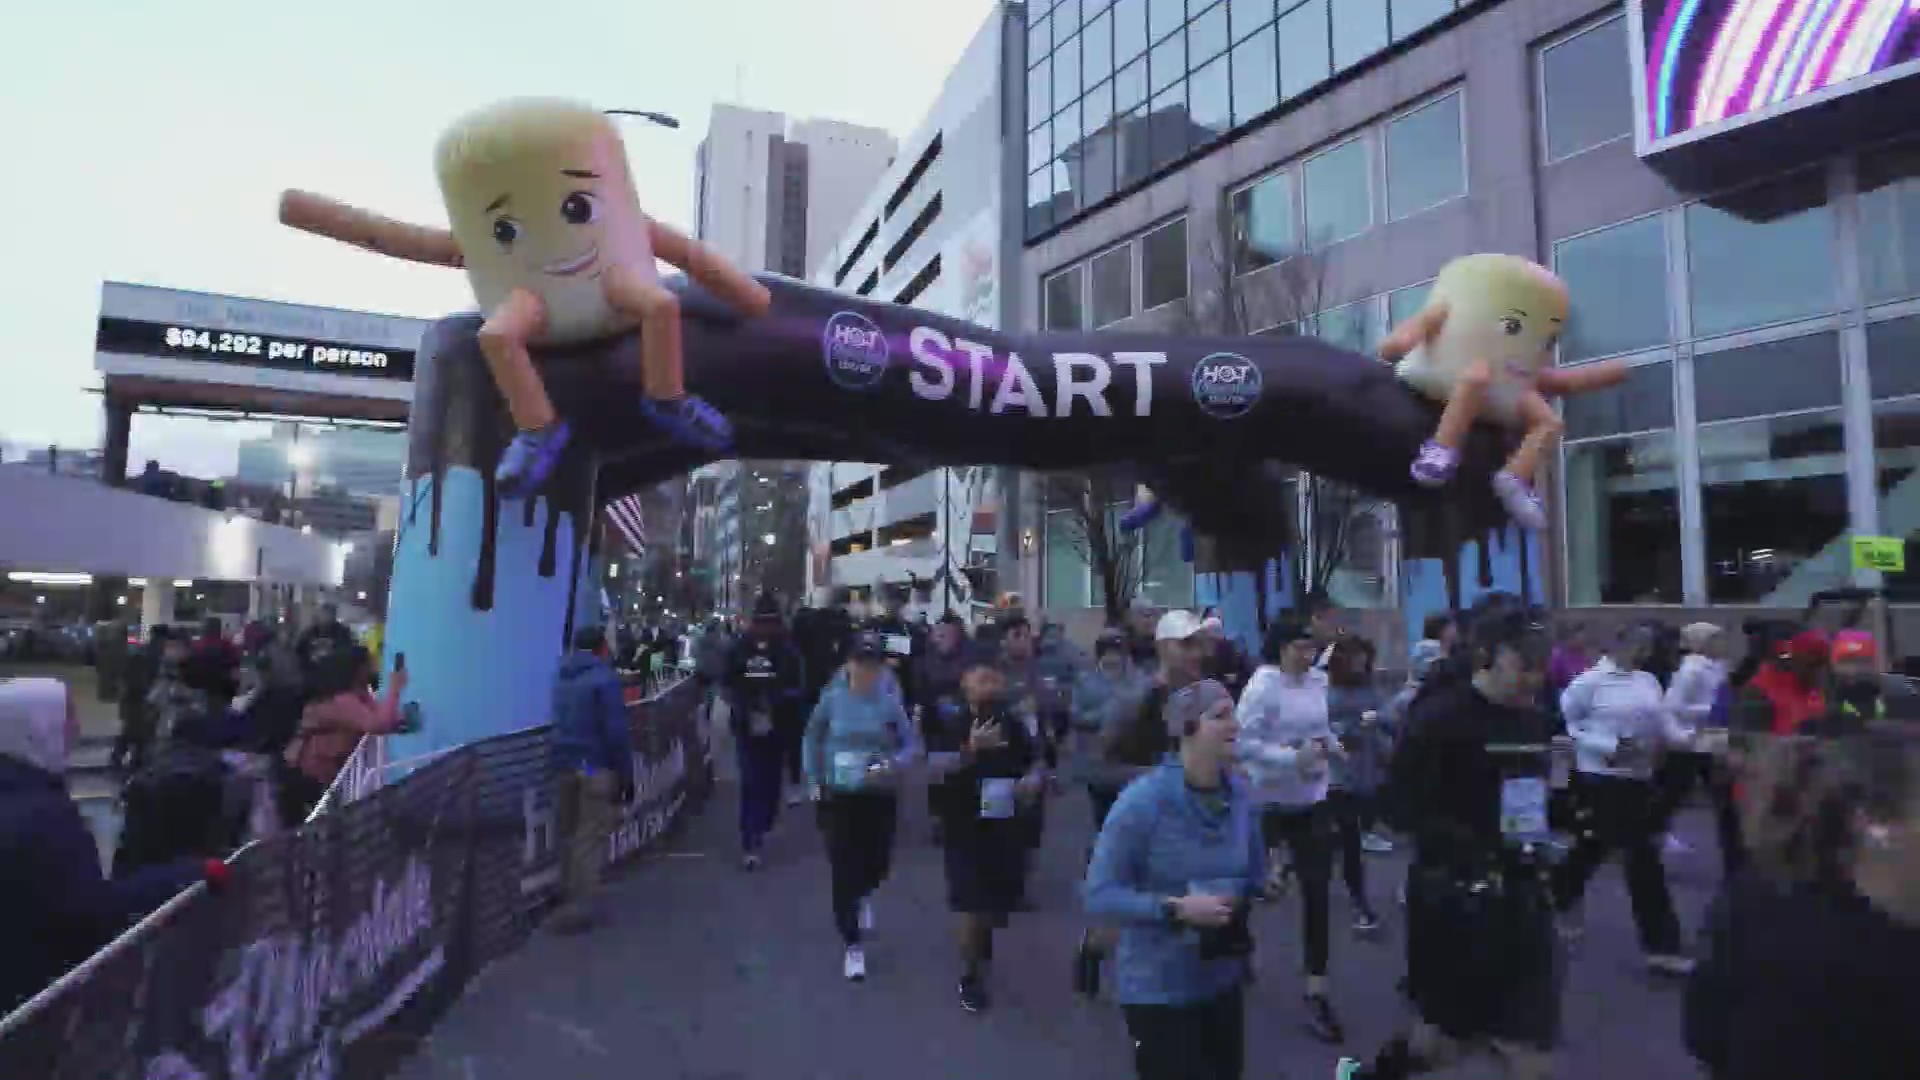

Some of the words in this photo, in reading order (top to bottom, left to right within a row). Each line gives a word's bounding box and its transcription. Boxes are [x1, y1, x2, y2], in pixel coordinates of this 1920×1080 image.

[165, 327, 261, 356] $94,292
[268, 341, 307, 360] per
[312, 344, 388, 369] person
[835, 324, 878, 348] HOT
[909, 326, 1168, 417] START
[1203, 365, 1250, 384] HOT
